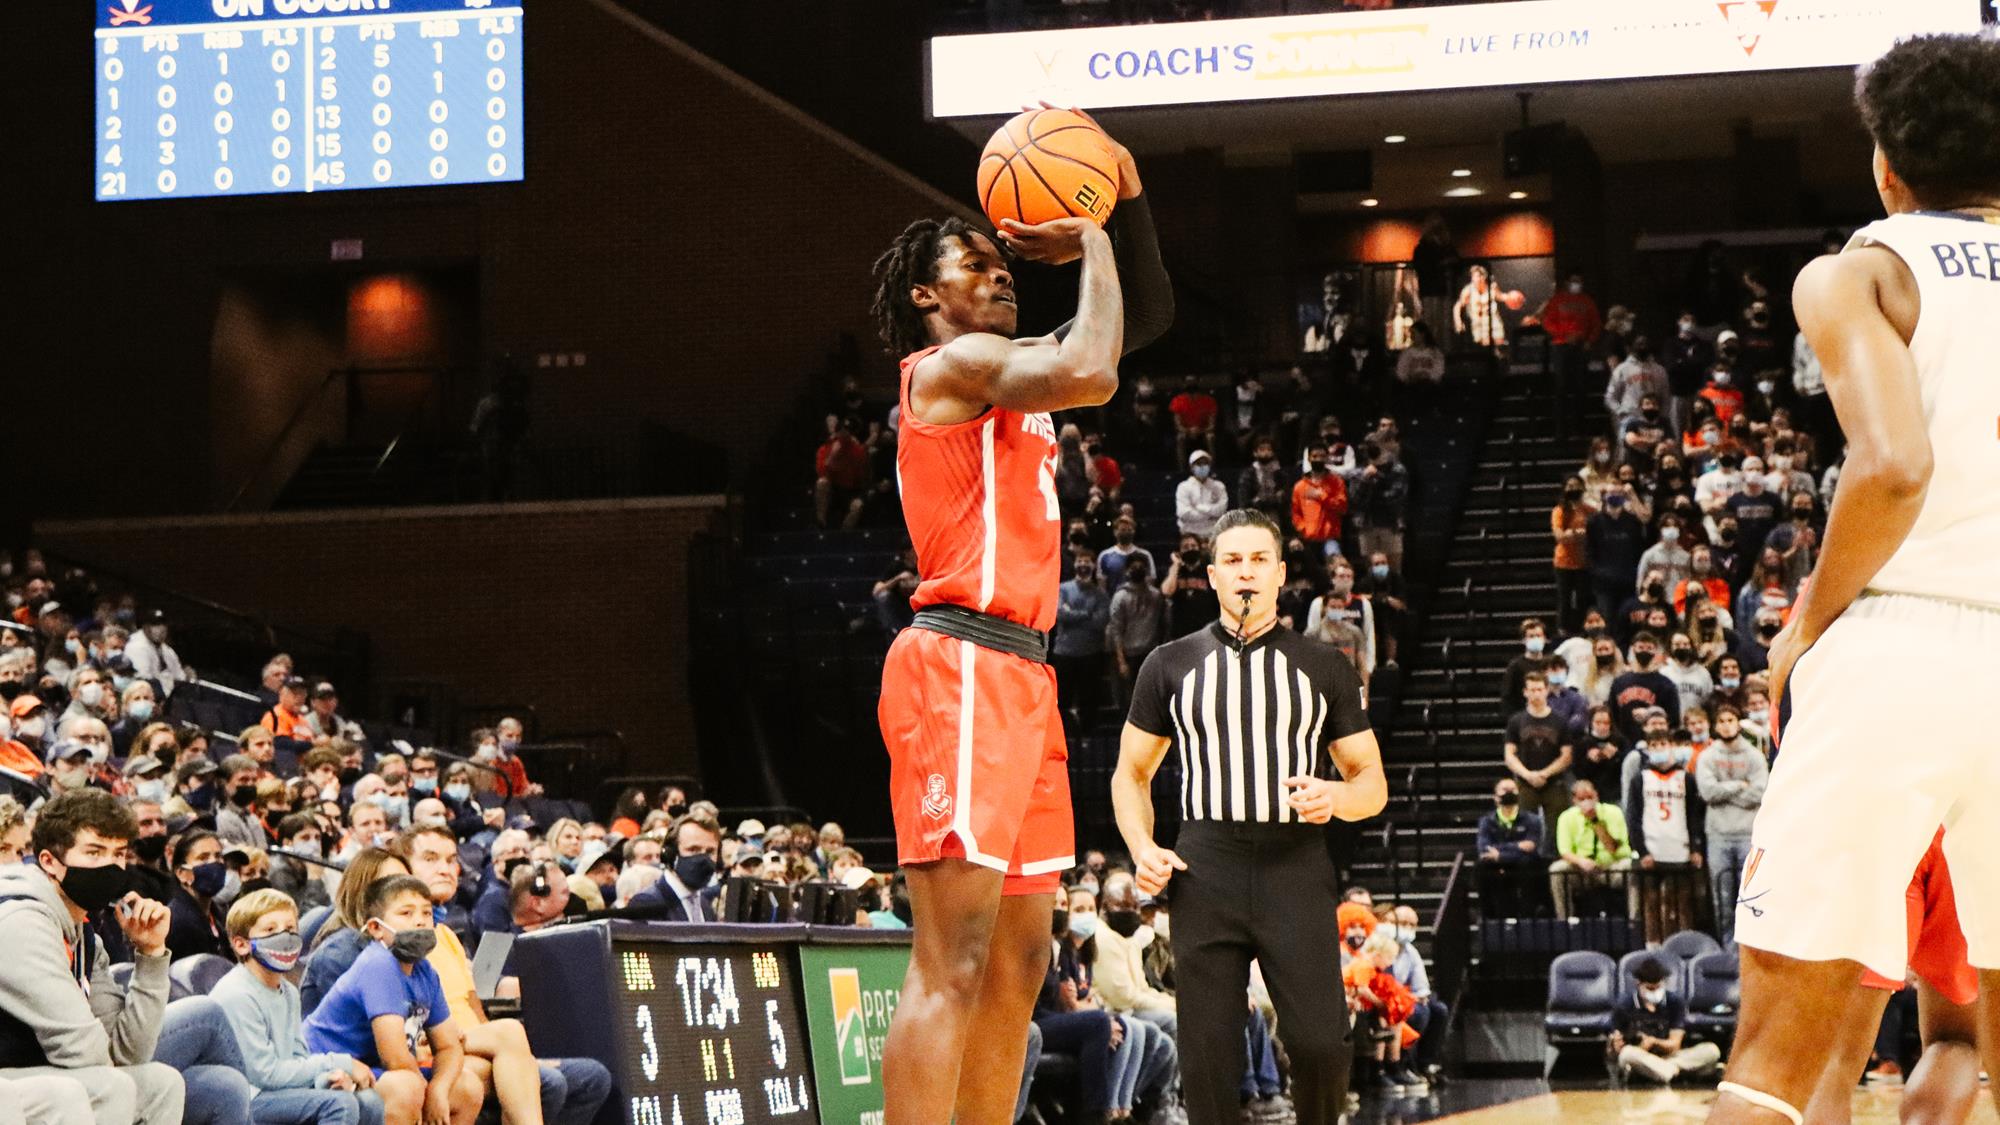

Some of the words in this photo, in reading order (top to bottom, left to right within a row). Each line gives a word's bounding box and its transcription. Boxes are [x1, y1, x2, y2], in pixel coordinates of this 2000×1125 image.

[143, 34, 179, 52] PTS
[359, 23, 396, 42] PTS
[104, 58, 124, 81] 0
[157, 55, 177, 79] 0
[218, 52, 228, 75] 1
[271, 49, 290, 73] 0
[320, 47, 337, 70] 2
[374, 44, 390, 68] 5
[432, 41, 443, 64] 1
[486, 38, 506, 62] 0
[1088, 44, 1254, 80] COACH'S
[1445, 35, 1500, 54] LIVE
[1513, 30, 1590, 51] FROM
[109, 87, 119, 110] 1
[158, 84, 177, 109] 0
[214, 81, 233, 106] 0
[276, 79, 286, 102] 1
[321, 76, 337, 100] 5
[372, 74, 392, 98] 0
[433, 71, 443, 93] 1
[486, 67, 506, 92] 0
[105, 116, 122, 139] 2
[157, 113, 177, 137] 0
[214, 110, 233, 134] 0
[271, 107, 291, 132] 0
[315, 105, 341, 129] 13
[372, 103, 392, 126] 0
[429, 99, 449, 123] 0
[487, 96, 506, 121] 0
[105, 144, 122, 167] 4
[159, 141, 175, 165] 3
[218, 139, 228, 162] 1
[272, 135, 291, 160] 0
[316, 133, 342, 157] 15
[372, 130, 392, 154] 0
[429, 127, 449, 152] 0
[487, 125, 506, 149] 0
[101, 172, 126, 196] 21
[157, 169, 177, 193] 0
[214, 166, 233, 190] 0
[271, 164, 291, 188] 0
[313, 161, 346, 184] 45
[373, 159, 392, 183] 0
[429, 156, 449, 180] 0
[487, 153, 507, 177] 0
[1074, 184, 1112, 226] ELIT
[863, 989, 900, 1028] PRE
[636, 1004, 660, 1082] 3
[765, 1000, 787, 1070] 5
